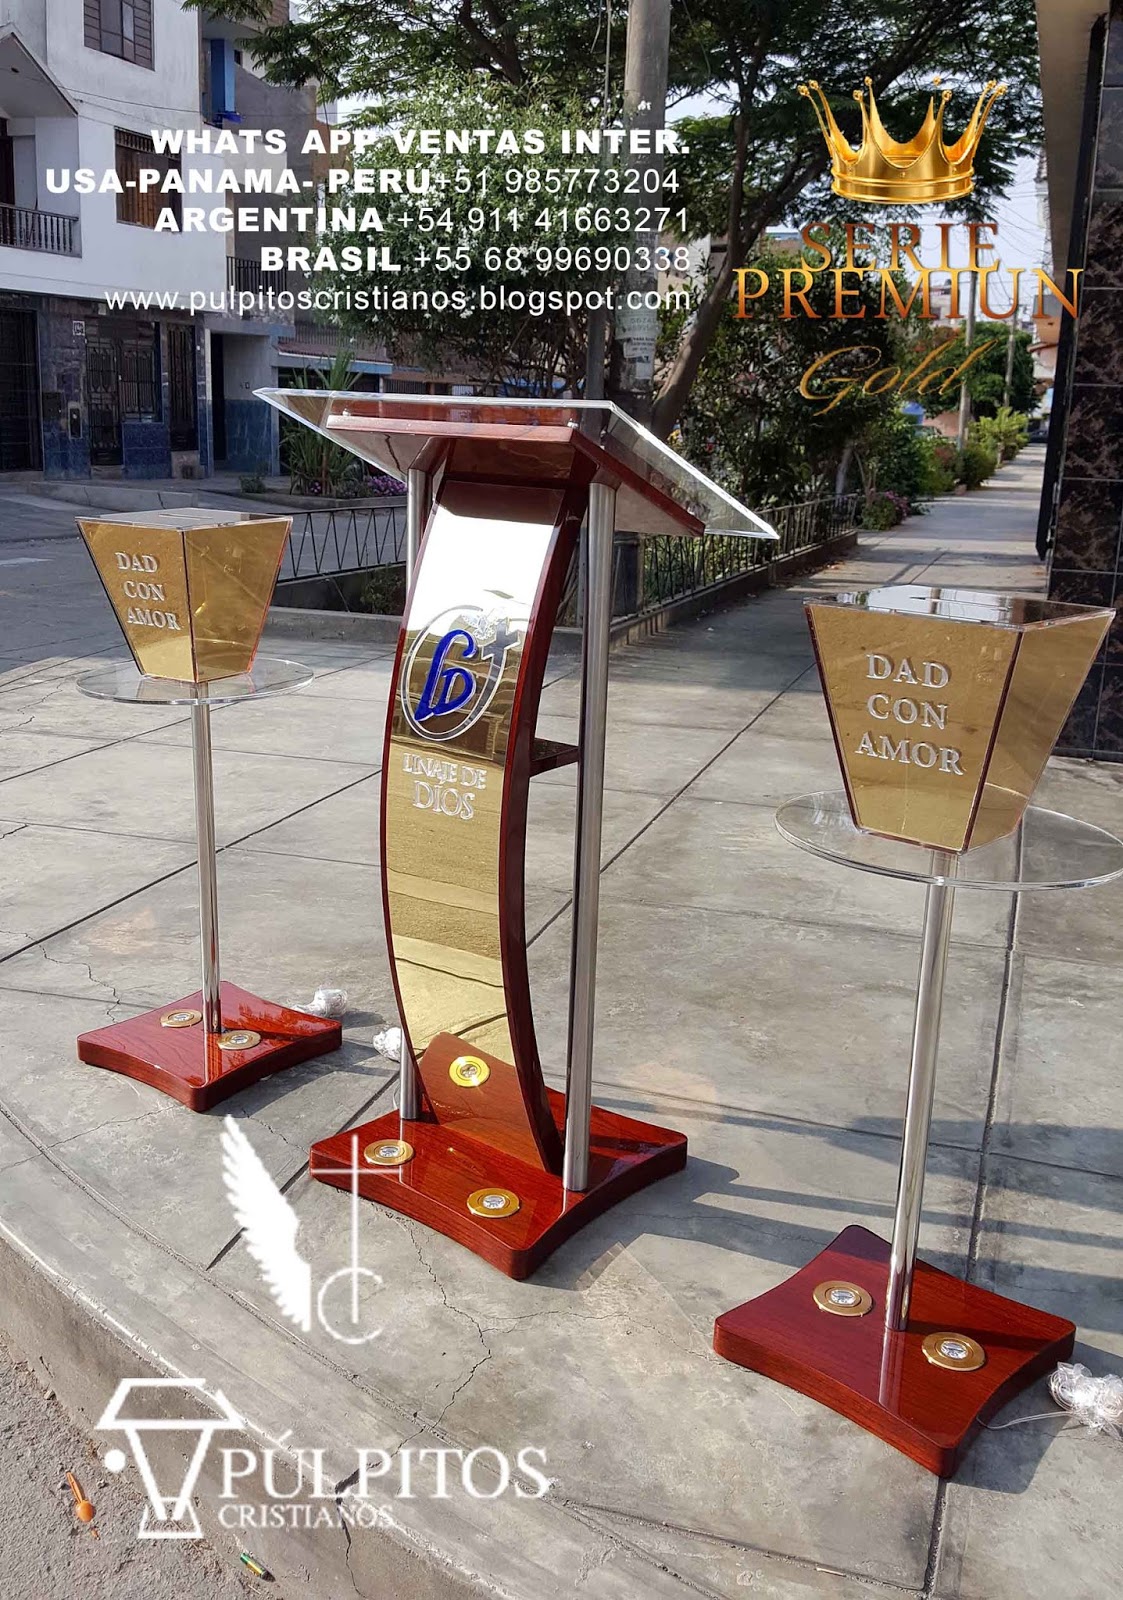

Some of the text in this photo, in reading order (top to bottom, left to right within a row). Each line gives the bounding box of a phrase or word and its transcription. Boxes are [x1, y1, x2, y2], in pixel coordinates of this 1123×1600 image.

[114, 552, 158, 573] DAD
[123, 580, 165, 602] CON
[126, 607, 182, 631] AMOR
[865, 652, 951, 689] DAD
[866, 692, 948, 730] CON
[402, 753, 488, 790] LINAJE DE
[854, 731, 966, 776] AMOR
[412, 780, 476, 820] DIOS
